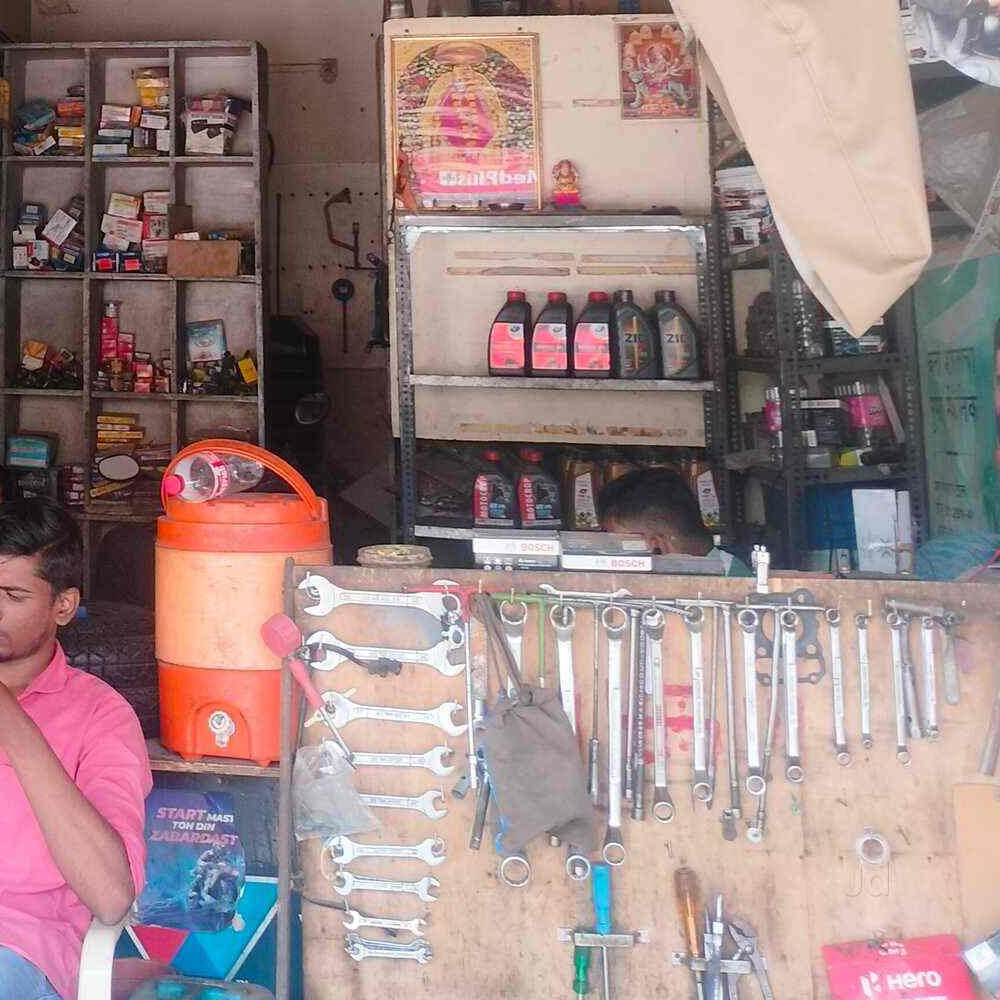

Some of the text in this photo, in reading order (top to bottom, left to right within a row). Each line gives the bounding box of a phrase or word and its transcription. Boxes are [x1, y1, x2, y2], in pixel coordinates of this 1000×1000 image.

[519, 542, 554, 552] BOSCH
[610, 558, 646, 568] BOSCH
[155, 807, 207, 820] START
[172, 821, 216, 831] TOH DIN
[150, 830, 239, 846] ZABARDAST
[886, 969, 942, 991] Hero
